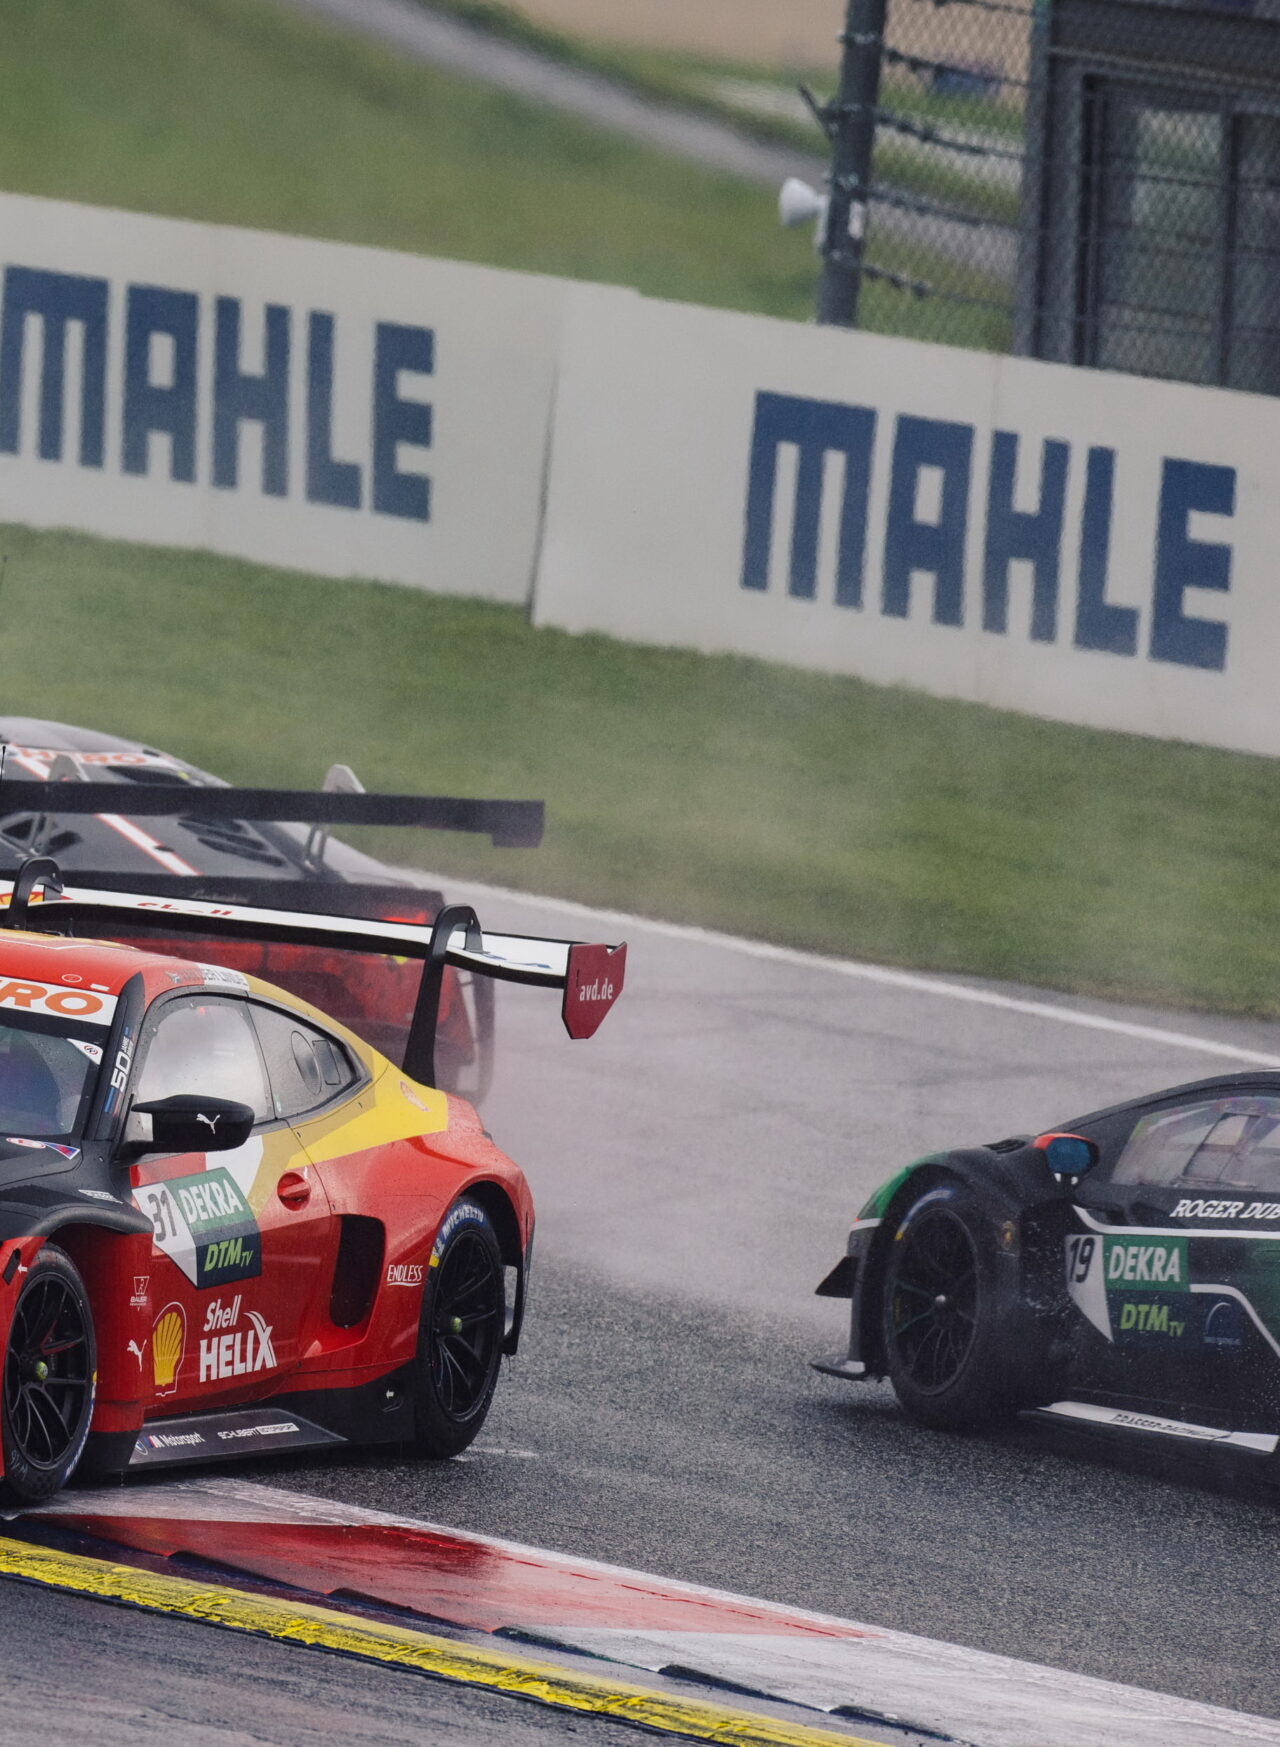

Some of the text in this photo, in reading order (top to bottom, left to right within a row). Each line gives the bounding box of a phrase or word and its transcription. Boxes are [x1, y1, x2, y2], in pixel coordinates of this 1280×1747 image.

[740, 389, 1237, 671] MAHLE
[579, 977, 614, 1001] avd.de
[147, 1190, 177, 1242] 31
[178, 1178, 244, 1224] DEKRA
[1168, 1199, 1245, 1218] ROGER
[387, 1265, 423, 1281] ENDLESS
[1070, 1237, 1095, 1283] 19
[1108, 1245, 1180, 1282] DEKRA
[203, 1294, 242, 1332] Shell
[199, 1310, 277, 1383] HELIX
